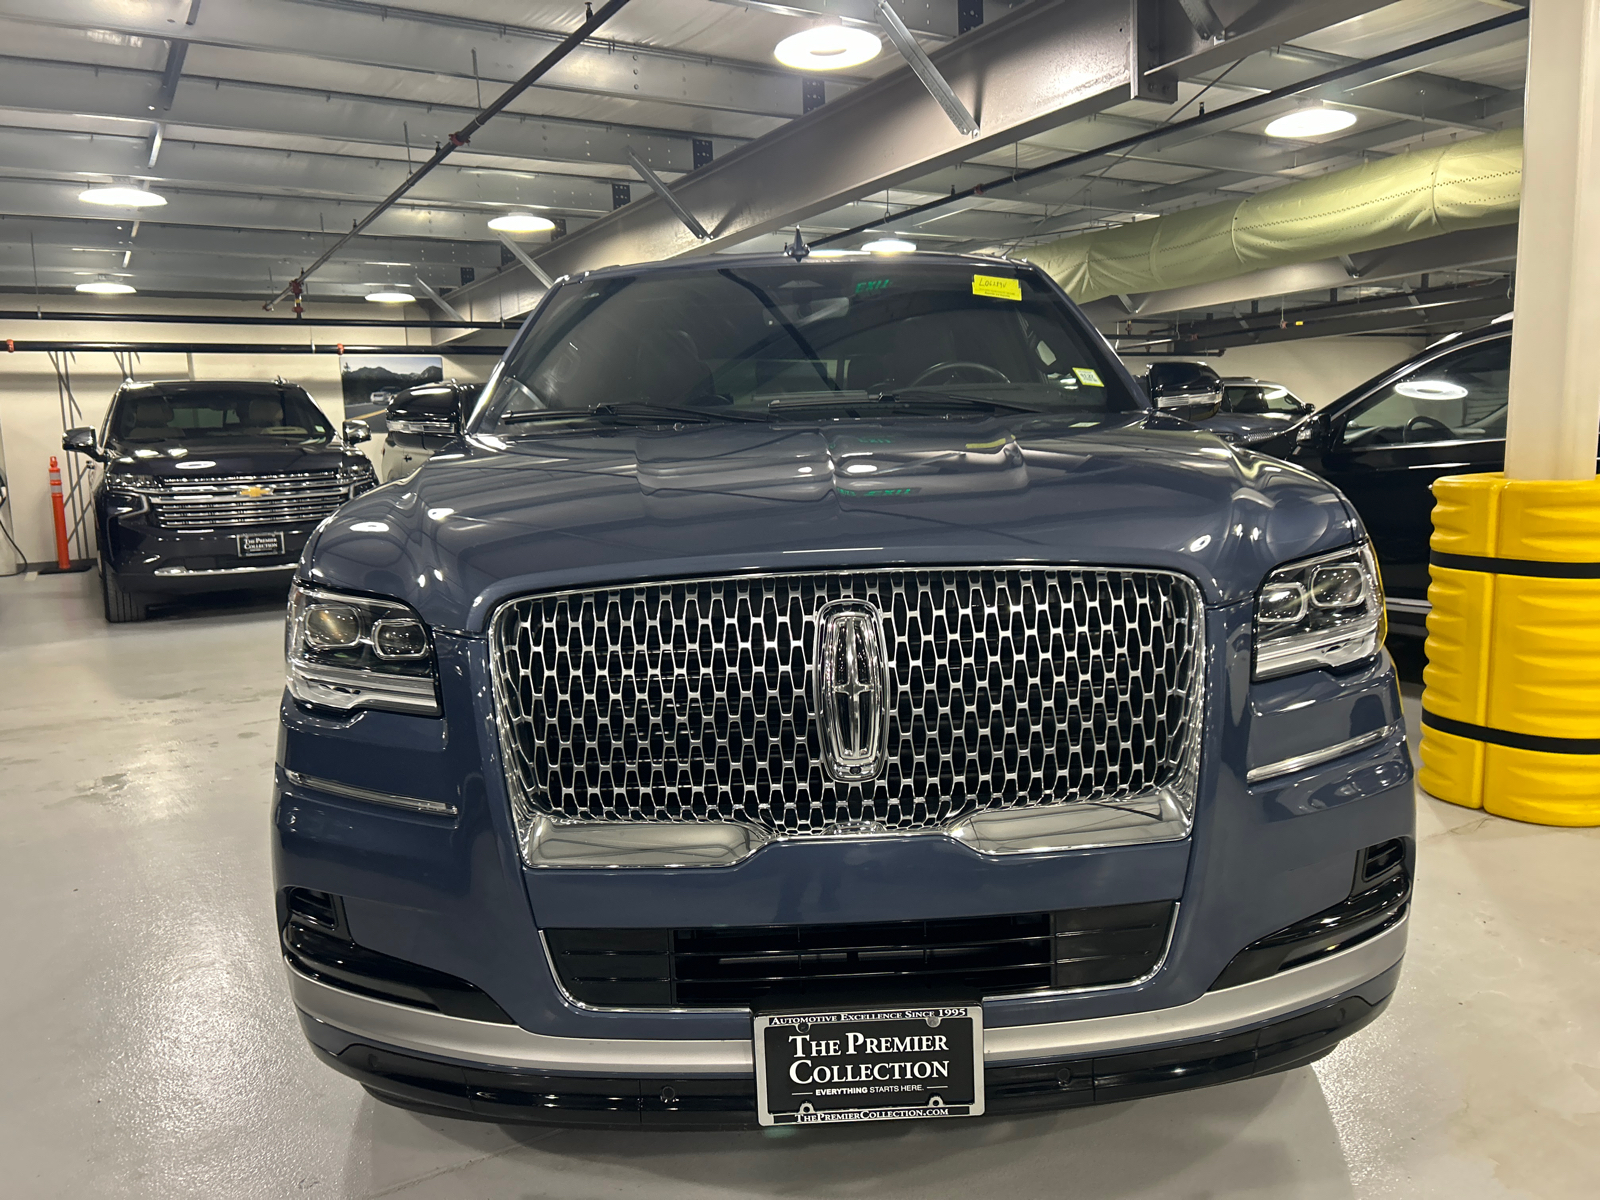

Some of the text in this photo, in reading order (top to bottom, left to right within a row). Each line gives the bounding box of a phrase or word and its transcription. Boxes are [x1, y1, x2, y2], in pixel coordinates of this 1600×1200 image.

[771, 1007, 967, 1025] AUTOMOTIVE EXCELLENCE SINCE 1995
[788, 1032, 950, 1058] THE PREMIER
[789, 1060, 950, 1084] COLLECTION
[815, 1087, 868, 1096] EVERYTHING
[900, 1084, 925, 1092] HERE.
[795, 1108, 949, 1123] THEPREMIERCOLLECTION.COM
